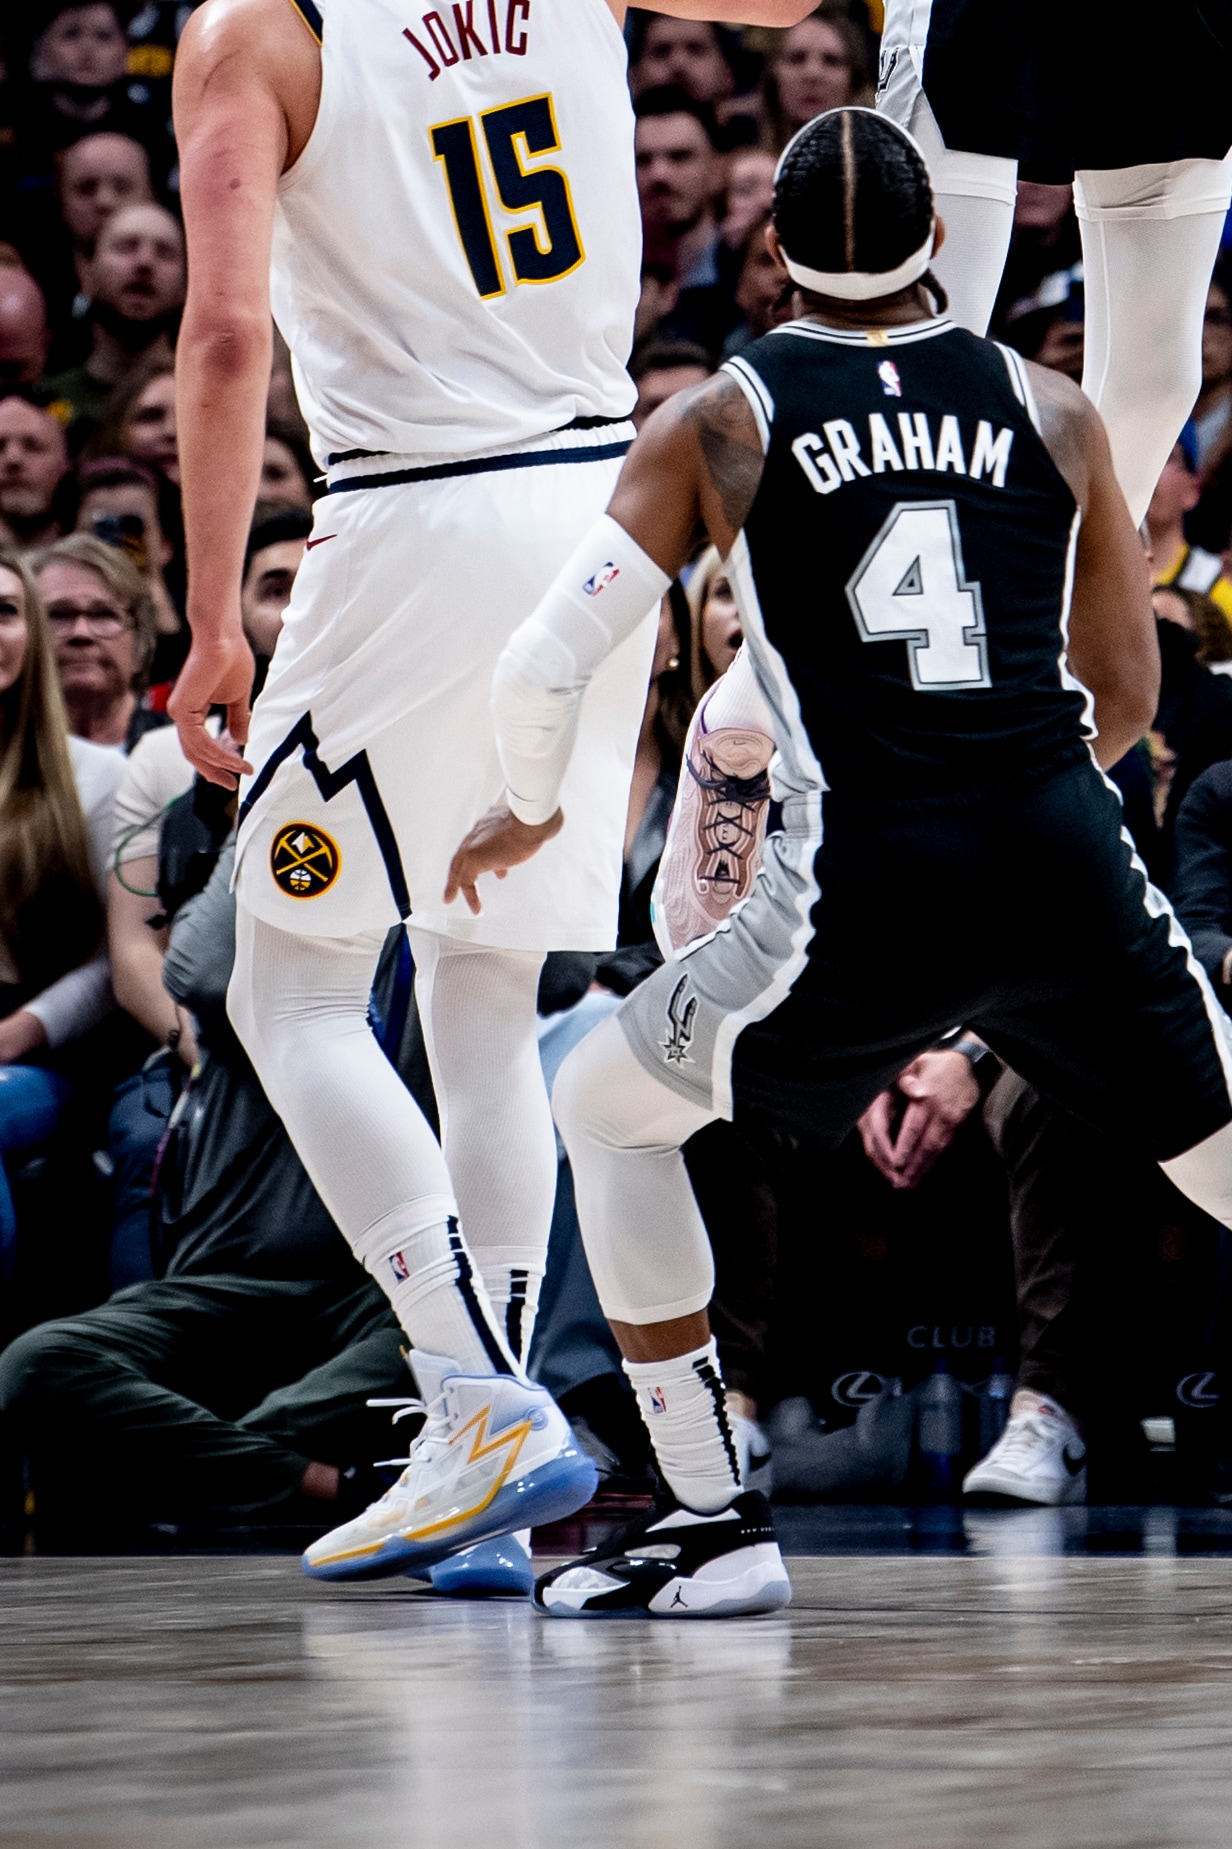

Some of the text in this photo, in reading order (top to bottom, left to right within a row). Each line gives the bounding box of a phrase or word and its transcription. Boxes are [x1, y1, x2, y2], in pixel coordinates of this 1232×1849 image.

[428, 91, 586, 301] 15
[791, 412, 1014, 494] GRAHAM
[845, 499, 993, 691] 4
[905, 1324, 997, 1350] CLUB
